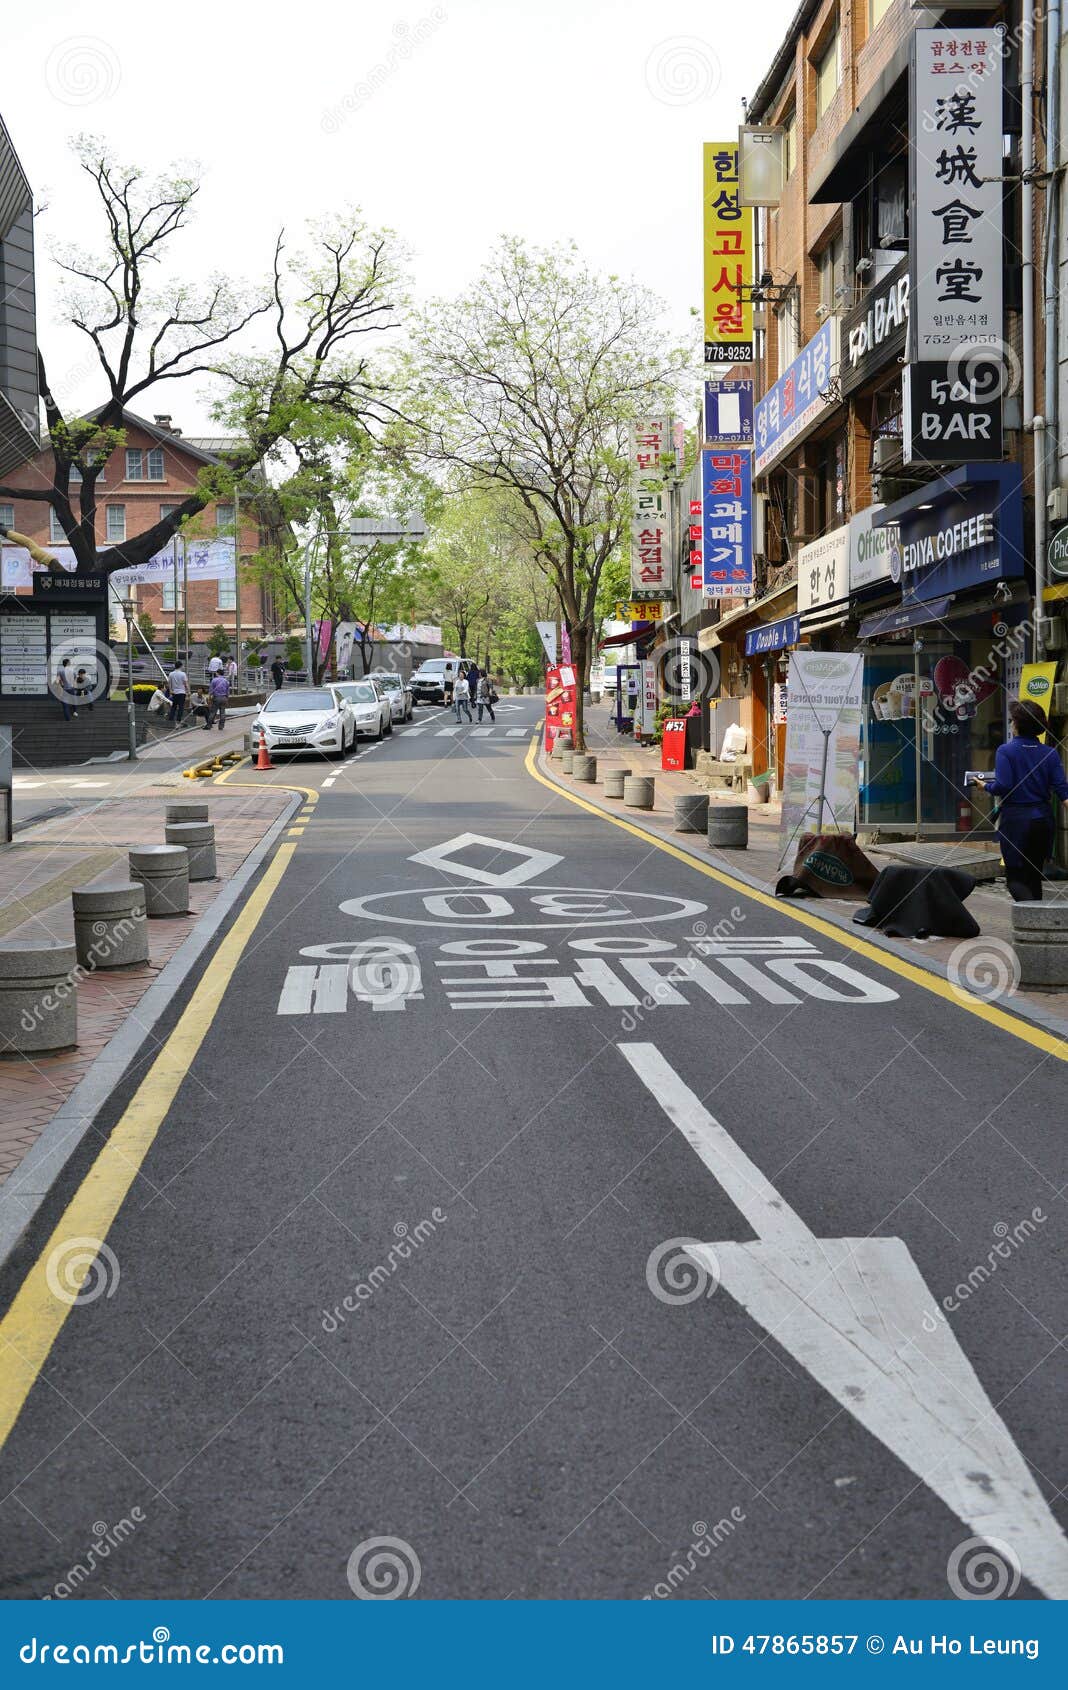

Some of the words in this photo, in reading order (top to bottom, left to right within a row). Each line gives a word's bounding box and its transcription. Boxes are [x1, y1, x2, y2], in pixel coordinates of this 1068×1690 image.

[930, 40, 988, 57] 곱창전골
[932, 91, 984, 303] 漢城食堂
[874, 274, 910, 345] BAR
[933, 314, 988, 326] 일반음식점
[707, 346, 751, 360] 778-9252
[923, 333, 998, 345] 752-2056
[708, 381, 751, 393] 법무사
[921, 412, 992, 440] BAR
[709, 500, 748, 565] 과메기
[903, 536, 934, 573] EDIYA
[936, 513, 993, 557] COFFEE
[638, 528, 664, 583] 삼겹살
[665, 721, 684, 731] #52
[277, 936, 901, 1015] 일방통행
